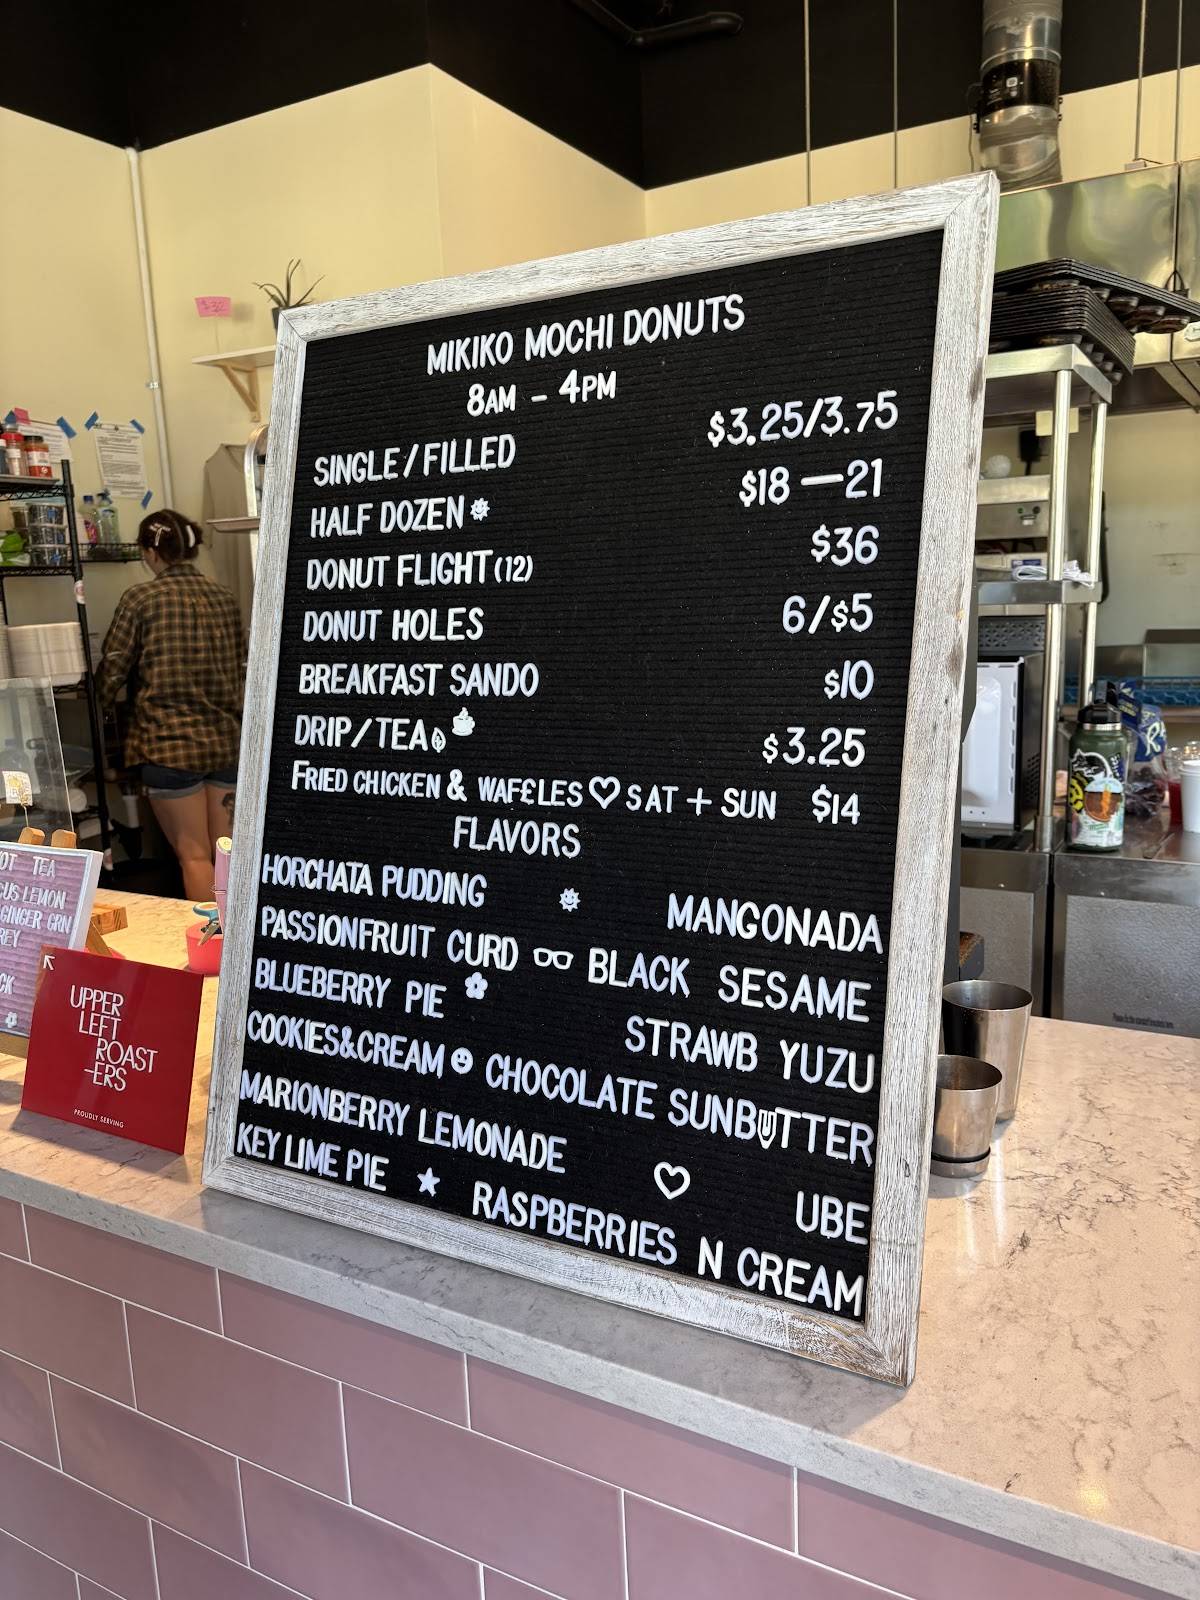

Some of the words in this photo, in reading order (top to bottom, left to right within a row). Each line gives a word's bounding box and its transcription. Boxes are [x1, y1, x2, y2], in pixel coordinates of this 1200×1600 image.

[426, 330, 514, 376] MIKIKO
[524, 313, 614, 362] MOCHI
[623, 293, 745, 346] DONUTS
[466, 383, 517, 417] 8AM
[558, 368, 617, 404] 4PM
[707, 389, 899, 448] $3.25/3.75
[313, 433, 516, 487] SINGLE/FILLED
[310, 502, 374, 539] HALF
[379, 494, 465, 534] DOZEN
[810, 523, 880, 567] $36
[306, 555, 391, 591] DONUT
[302, 609, 383, 643] DONUT
[391, 606, 485, 642] HOLES
[782, 592, 874, 635] 6/$5
[298, 663, 444, 697] BREAKFAST
[449, 662, 540, 698] SANDO
[823, 659, 875, 701] $10
[294, 714, 429, 752] DRIP/TEA
[761, 726, 867, 768] $3.25
[291, 759, 349, 793] FRIED
[352, 769, 442, 800] CHICKEN
[446, 768, 468, 802] &
[625, 783, 680, 814] SAT
[686, 787, 713, 817] +
[720, 787, 777, 821] SUN
[811, 783, 861, 825] $14
[453, 815, 581, 859] FLAVORS
[32, 855, 56, 879] TEA
[261, 853, 374, 897] HORCHATA
[381, 864, 488, 908] PUDDING
[22, 886, 66, 909] LEMON
[261, 904, 436, 959] PASSIONFRUIT
[446, 928, 519, 972] CURD
[667, 892, 884, 955] MANGONADA
[69, 984, 125, 1017] UPPER
[254, 957, 392, 1009] BLUEBERRY
[404, 980, 448, 1019] PIE
[587, 947, 691, 999] BLACK
[717, 964, 872, 1023] SESAME
[78, 1010, 122, 1040] LEFT
[247, 1010, 446, 1079] COOKIES&CREAM
[95, 1037, 159, 1073] ROAST
[624, 1015, 758, 1073] STRAWB
[779, 1039, 875, 1094] YUZU
[73, 1108, 99, 1121] PROUDLY
[99, 1115, 125, 1129] SERVING
[239, 1069, 411, 1137] MARIONBERRY
[417, 1107, 568, 1174] LEMONADE
[485, 1053, 658, 1120] CHOCOLATE
[667, 1088, 875, 1168] SUNBUTTER
[236, 1121, 282, 1161] KEY
[284, 1134, 341, 1178] LIME
[345, 1148, 390, 1192] PIE
[795, 1190, 870, 1245] UBE
[471, 1180, 678, 1266] RASPBERRIES
[697, 1236, 724, 1280] N
[737, 1246, 865, 1317] CREAM
